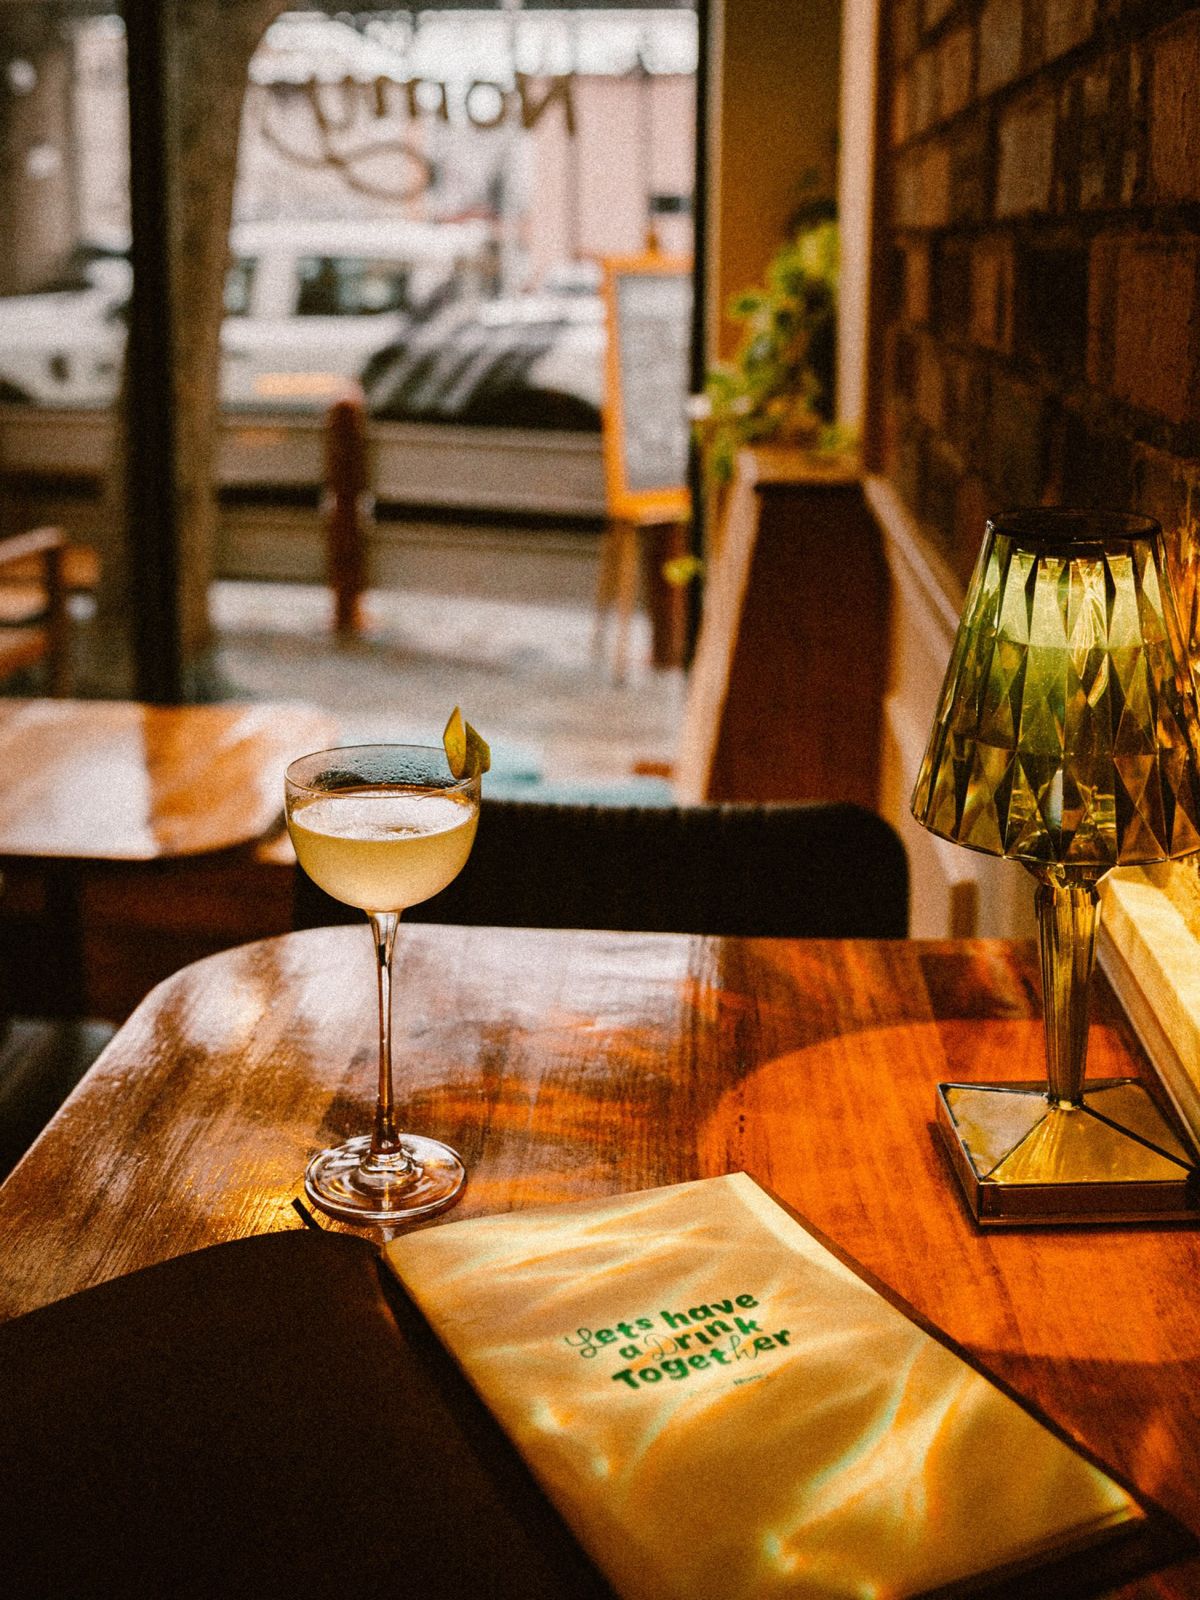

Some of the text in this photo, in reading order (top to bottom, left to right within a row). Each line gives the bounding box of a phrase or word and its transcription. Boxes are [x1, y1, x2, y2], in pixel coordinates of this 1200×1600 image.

[565, 1293, 759, 1358] Lets have
[619, 1316, 763, 1361] a Drink
[612, 1329, 791, 1389] Together
